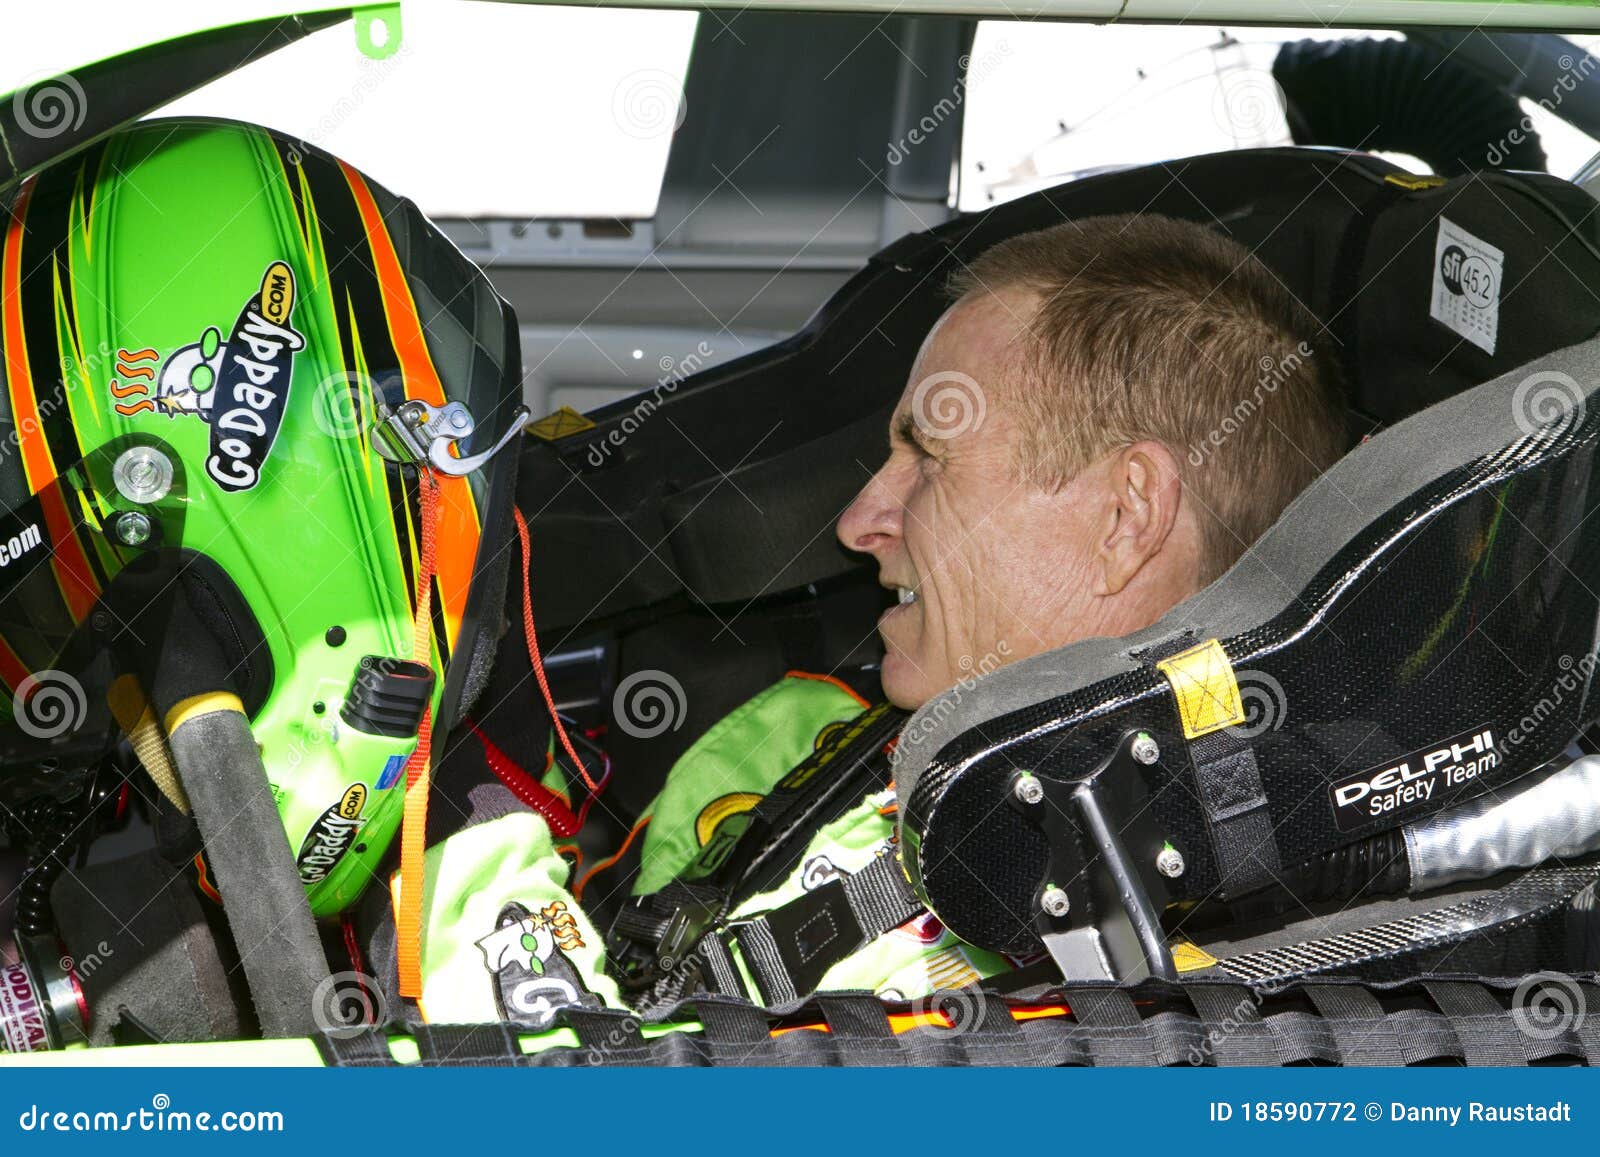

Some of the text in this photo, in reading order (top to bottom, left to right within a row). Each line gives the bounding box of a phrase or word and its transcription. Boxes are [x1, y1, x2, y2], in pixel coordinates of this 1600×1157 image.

[1463, 265, 1491, 300] 45.2
[1334, 730, 1494, 808] DELPHI
[1369, 752, 1496, 816] Safety Team
